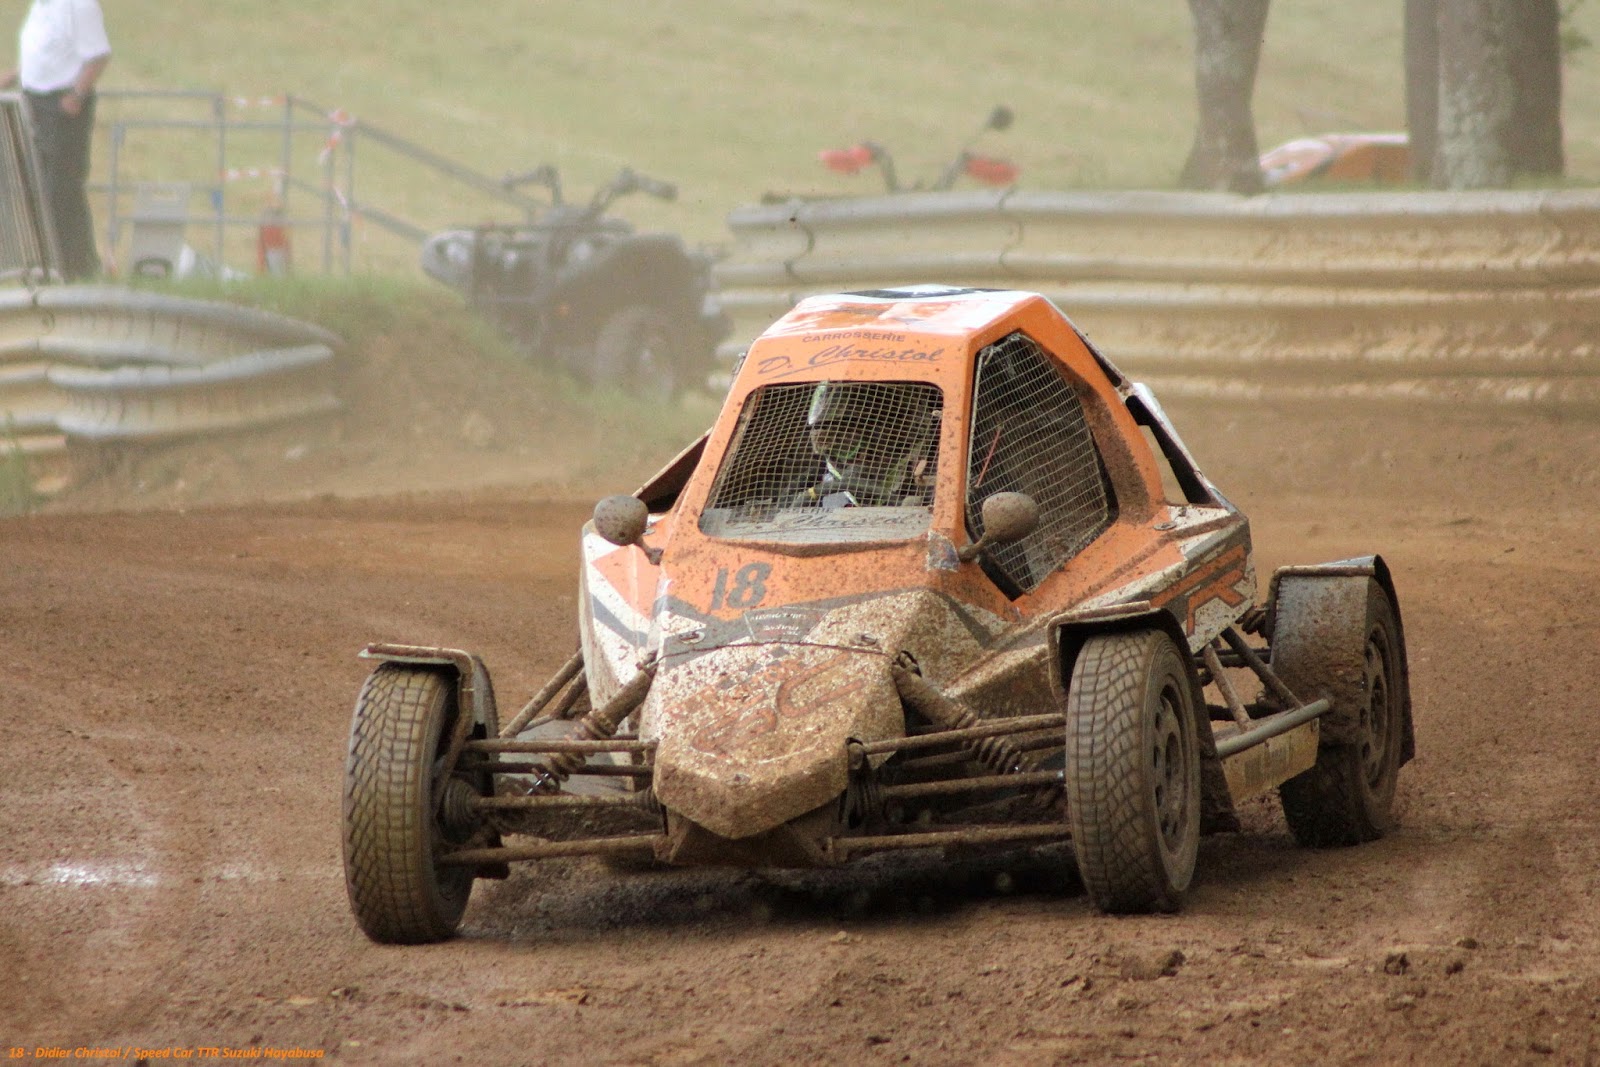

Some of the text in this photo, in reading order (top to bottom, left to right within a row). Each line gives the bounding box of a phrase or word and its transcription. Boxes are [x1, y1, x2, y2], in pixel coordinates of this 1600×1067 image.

[802, 332, 906, 344] CARROSSERIE
[808, 344, 945, 365] Christol
[710, 562, 772, 611] 18
